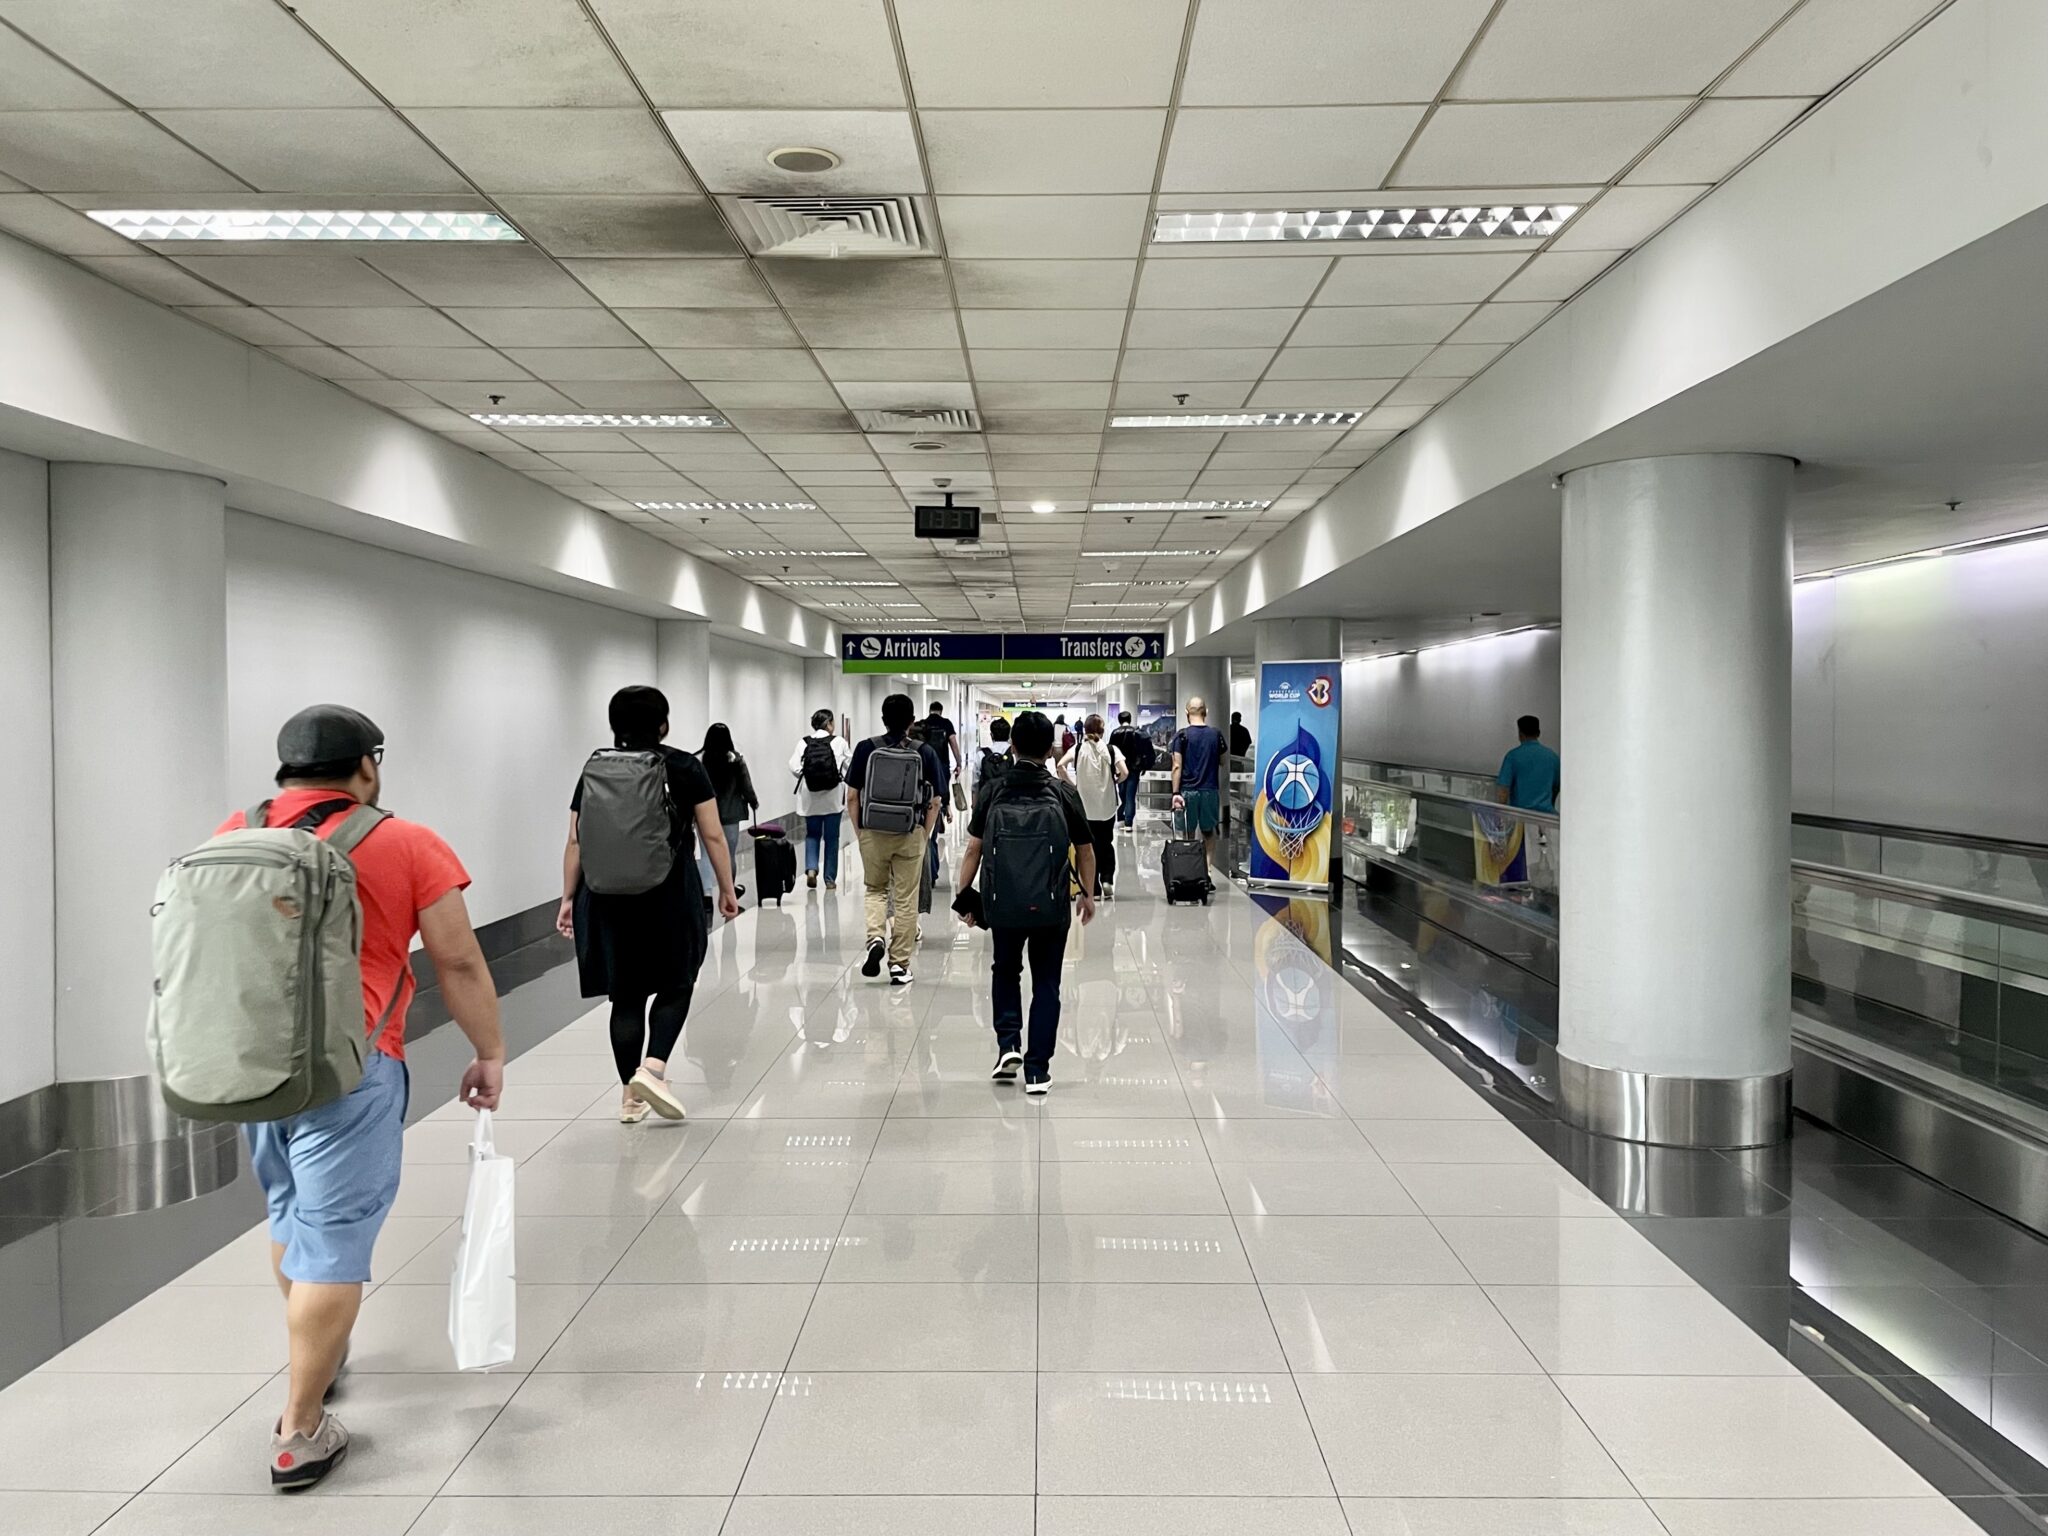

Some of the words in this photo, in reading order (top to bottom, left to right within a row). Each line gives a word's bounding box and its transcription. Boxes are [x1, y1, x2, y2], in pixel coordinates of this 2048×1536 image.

[884, 637, 941, 658] Arrivals
[1060, 637, 1123, 657] Transfers
[1118, 661, 1139, 671] Toilet
